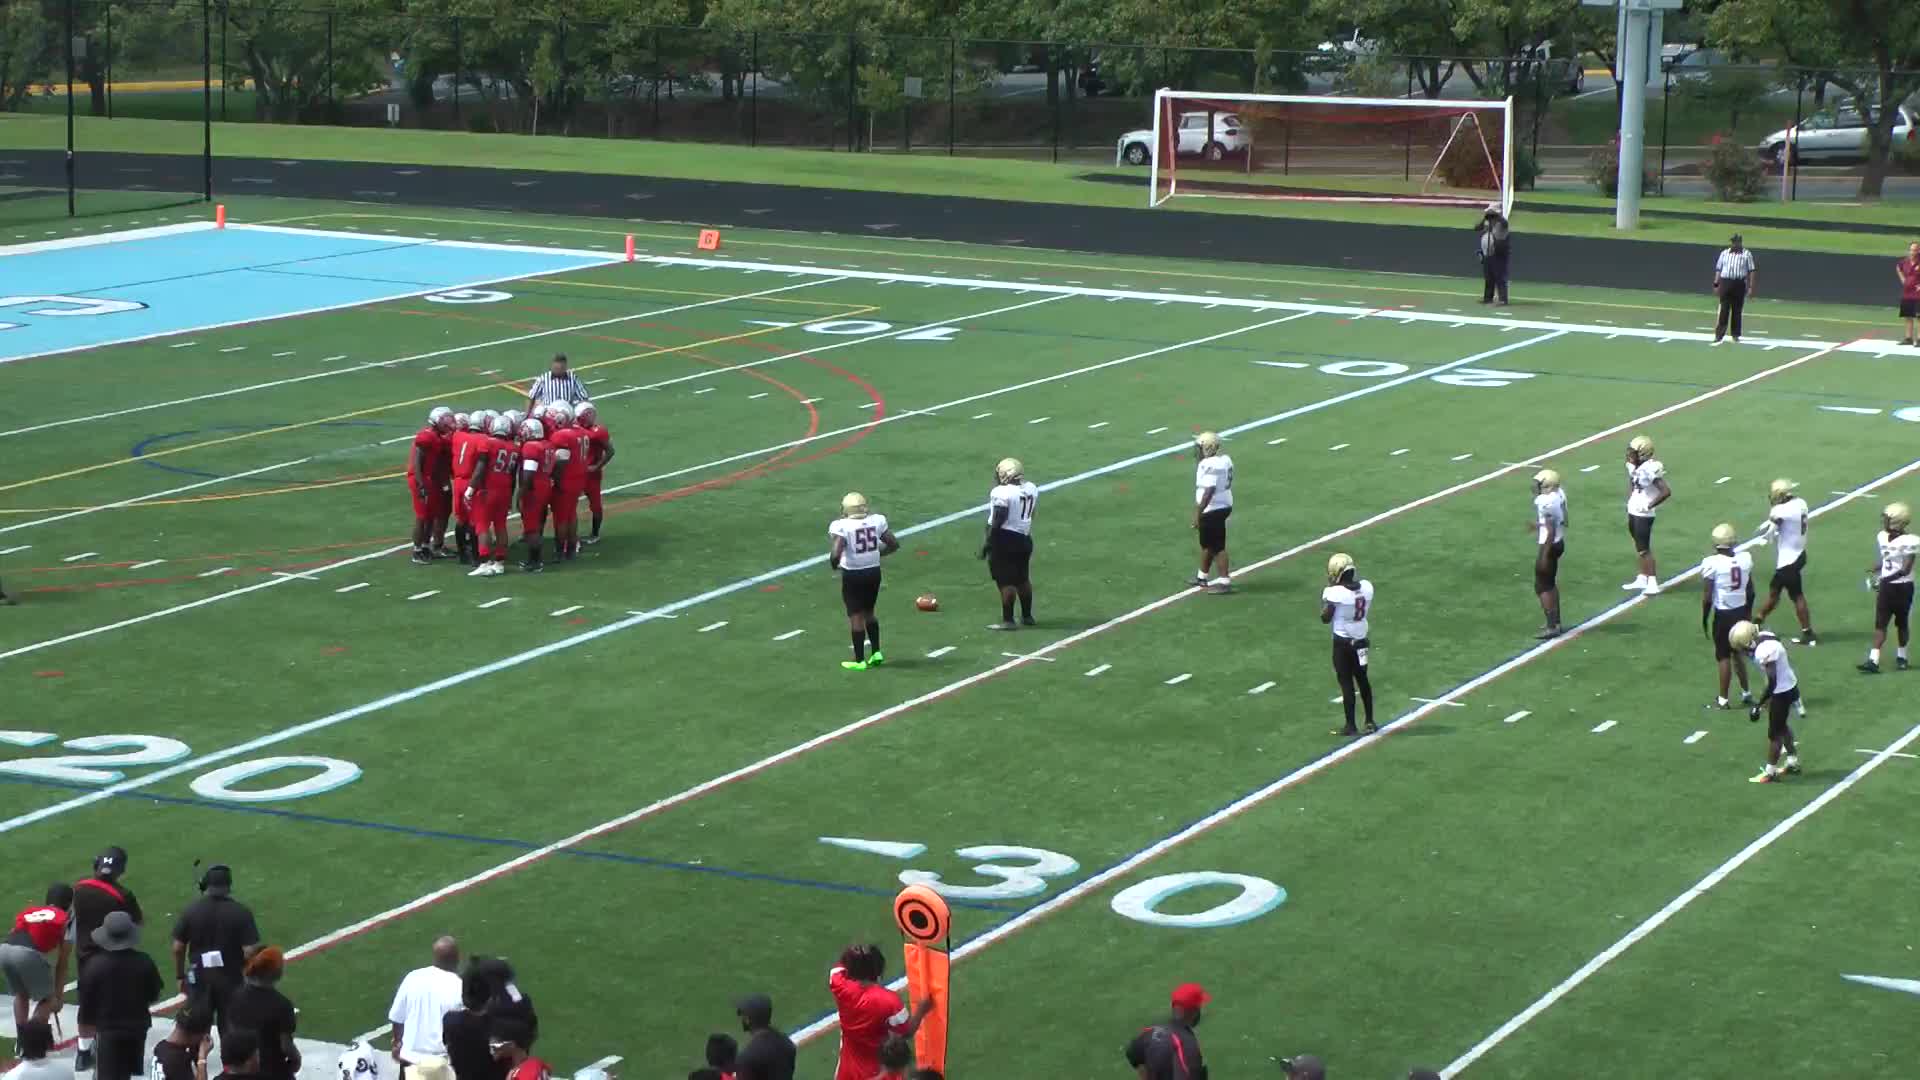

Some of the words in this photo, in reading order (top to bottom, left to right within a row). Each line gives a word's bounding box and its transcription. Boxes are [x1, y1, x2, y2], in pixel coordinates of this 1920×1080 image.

[855, 526, 877, 554] 55
[1730, 566, 1742, 591] 9
[1354, 596, 1367, 622] 8
[0, 733, 364, 802] 20
[898, 844, 1288, 929] 30
